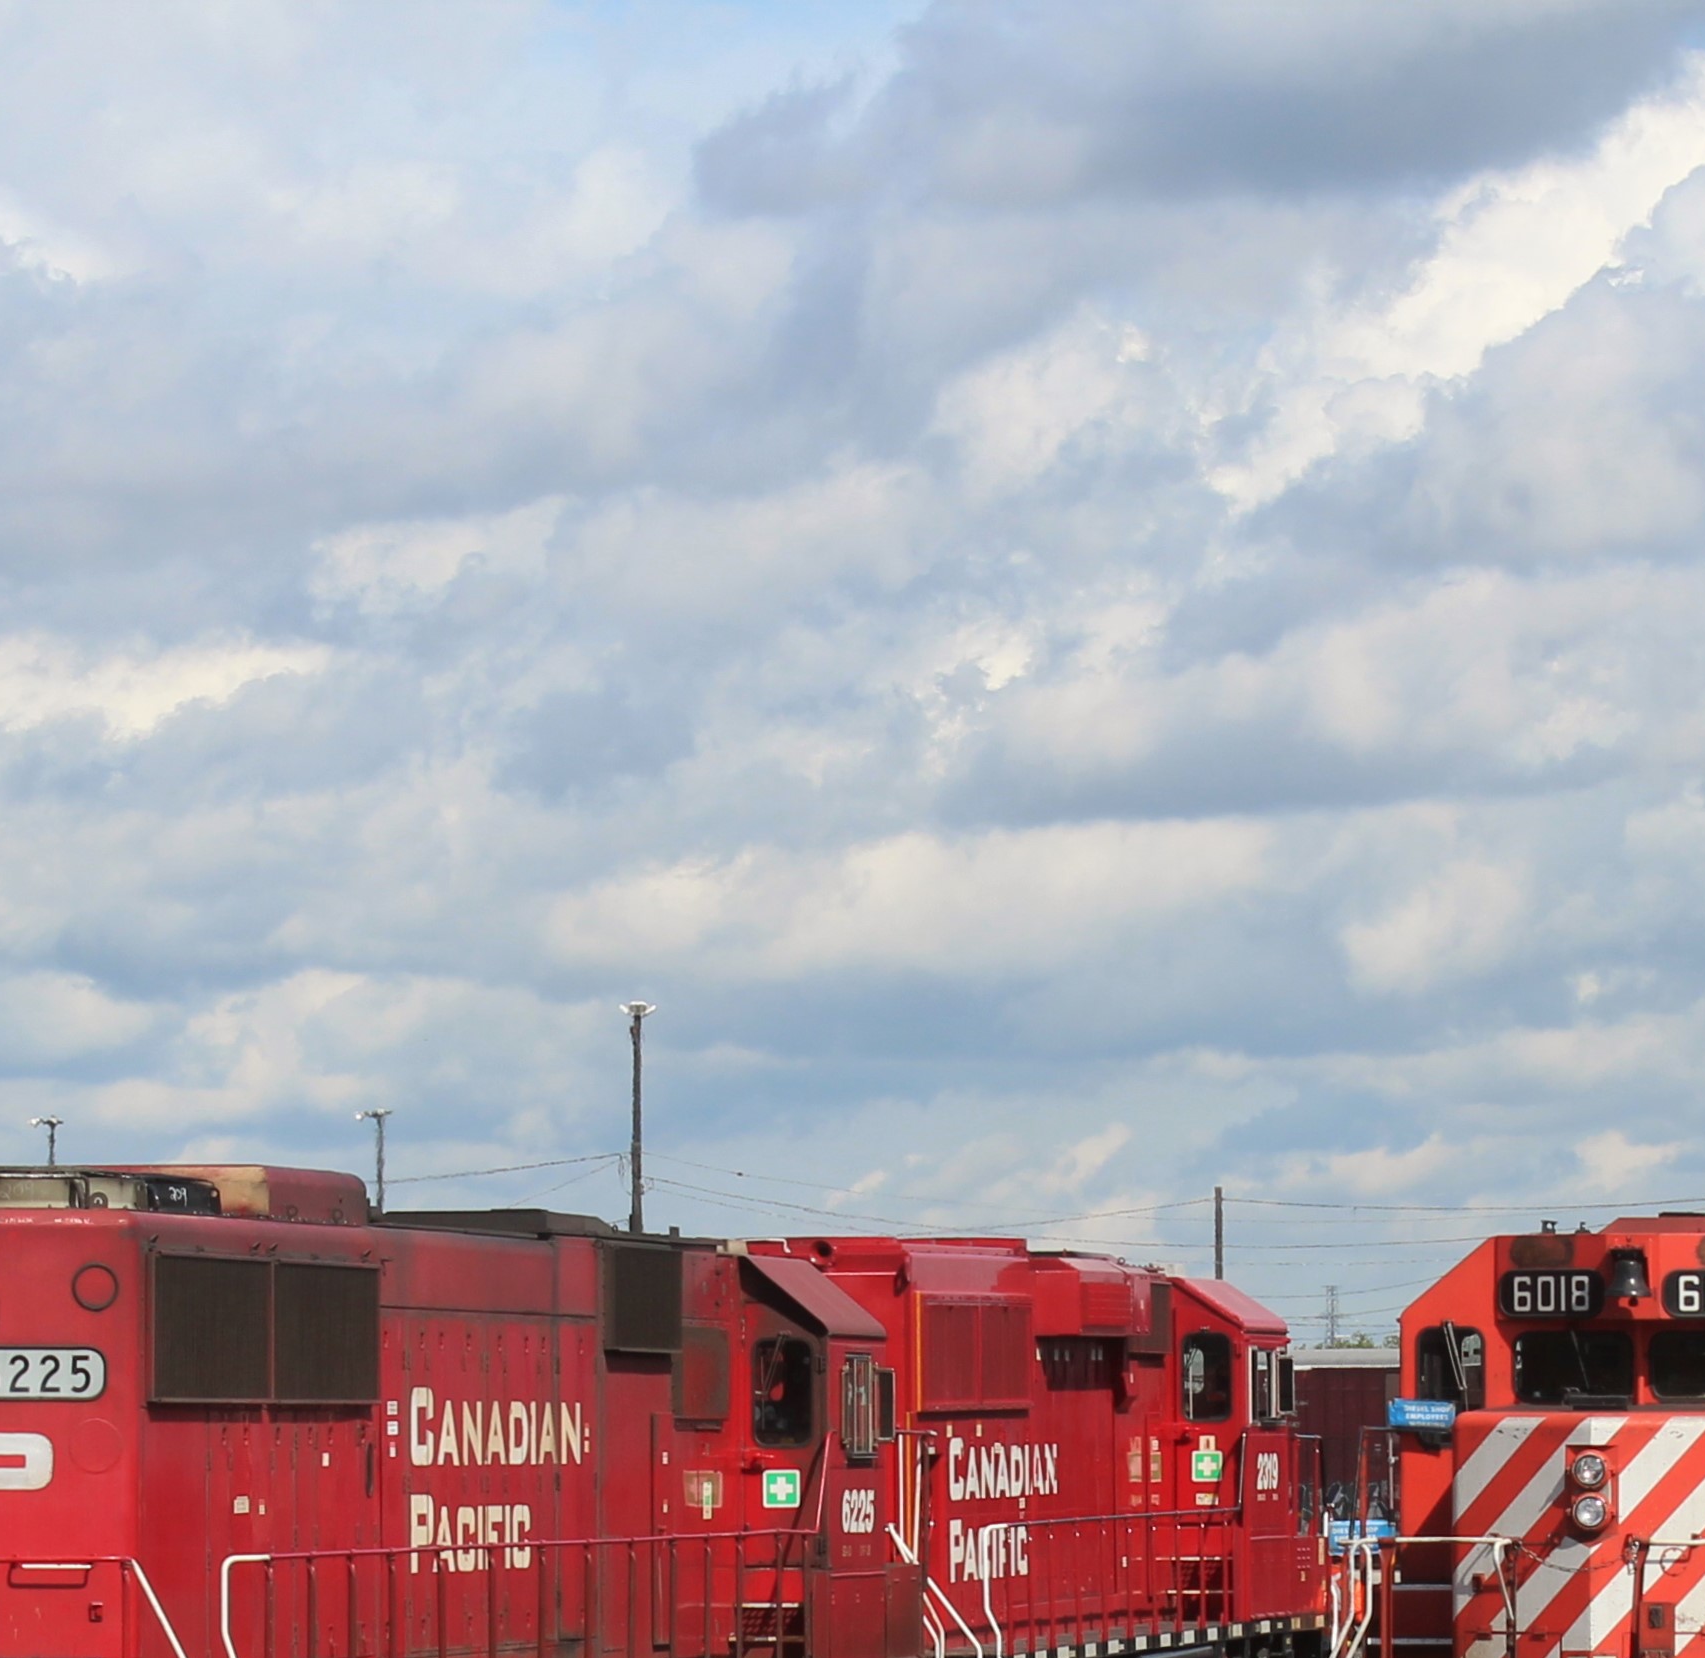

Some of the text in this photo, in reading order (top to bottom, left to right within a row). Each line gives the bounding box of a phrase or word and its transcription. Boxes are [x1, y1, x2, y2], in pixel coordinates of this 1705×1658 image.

[1513, 1275, 1589, 1312] 6018
[410, 1387, 581, 1466] CANADIAN
[949, 1437, 1058, 1501] CANADIAN
[410, 1494, 531, 1574] PACIFIC
[842, 1489, 875, 1533] 6225
[949, 1519, 1029, 1583] PACIFIC
